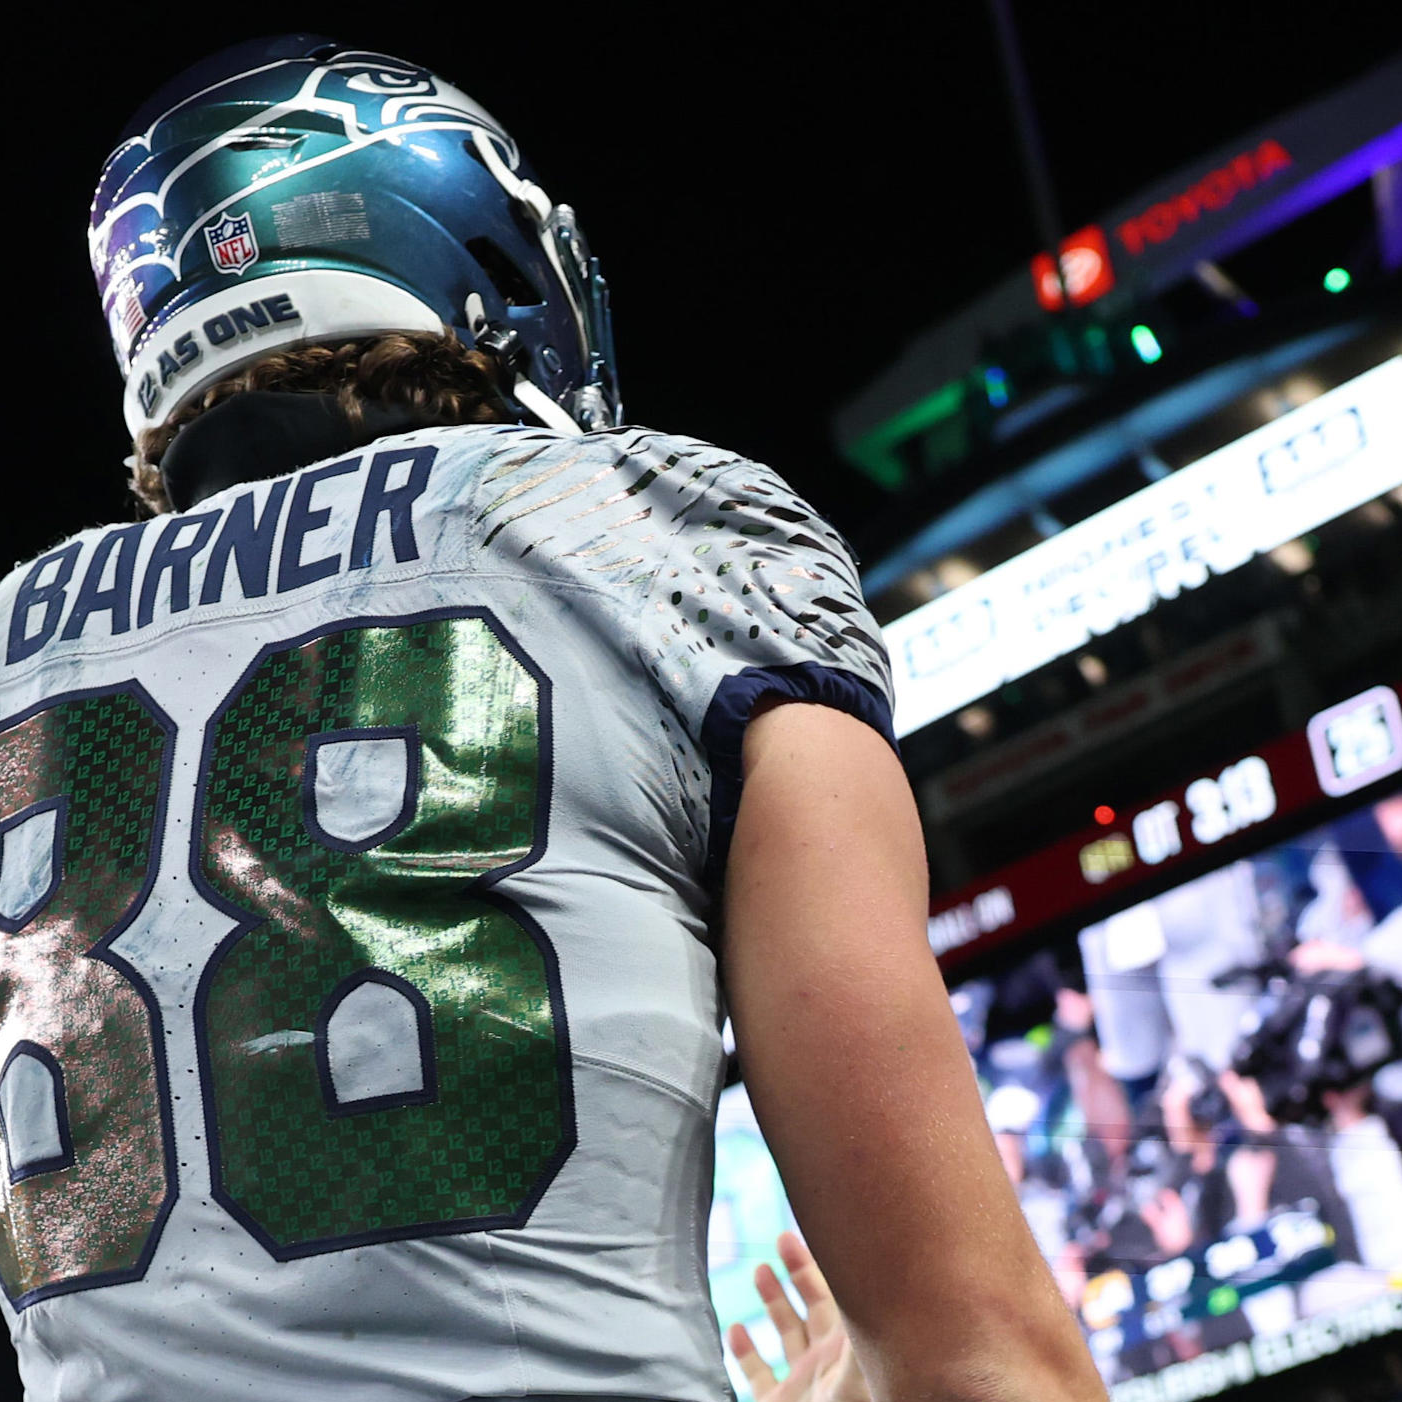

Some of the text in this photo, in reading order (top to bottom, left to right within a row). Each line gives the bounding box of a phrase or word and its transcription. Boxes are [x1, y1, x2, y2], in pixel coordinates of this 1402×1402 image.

[1115, 138, 1293, 257] TOYOTA
[216, 237, 253, 266] NFL
[156, 330, 200, 386] AS
[202, 292, 302, 346] ONE
[5, 445, 439, 666] BARNER
